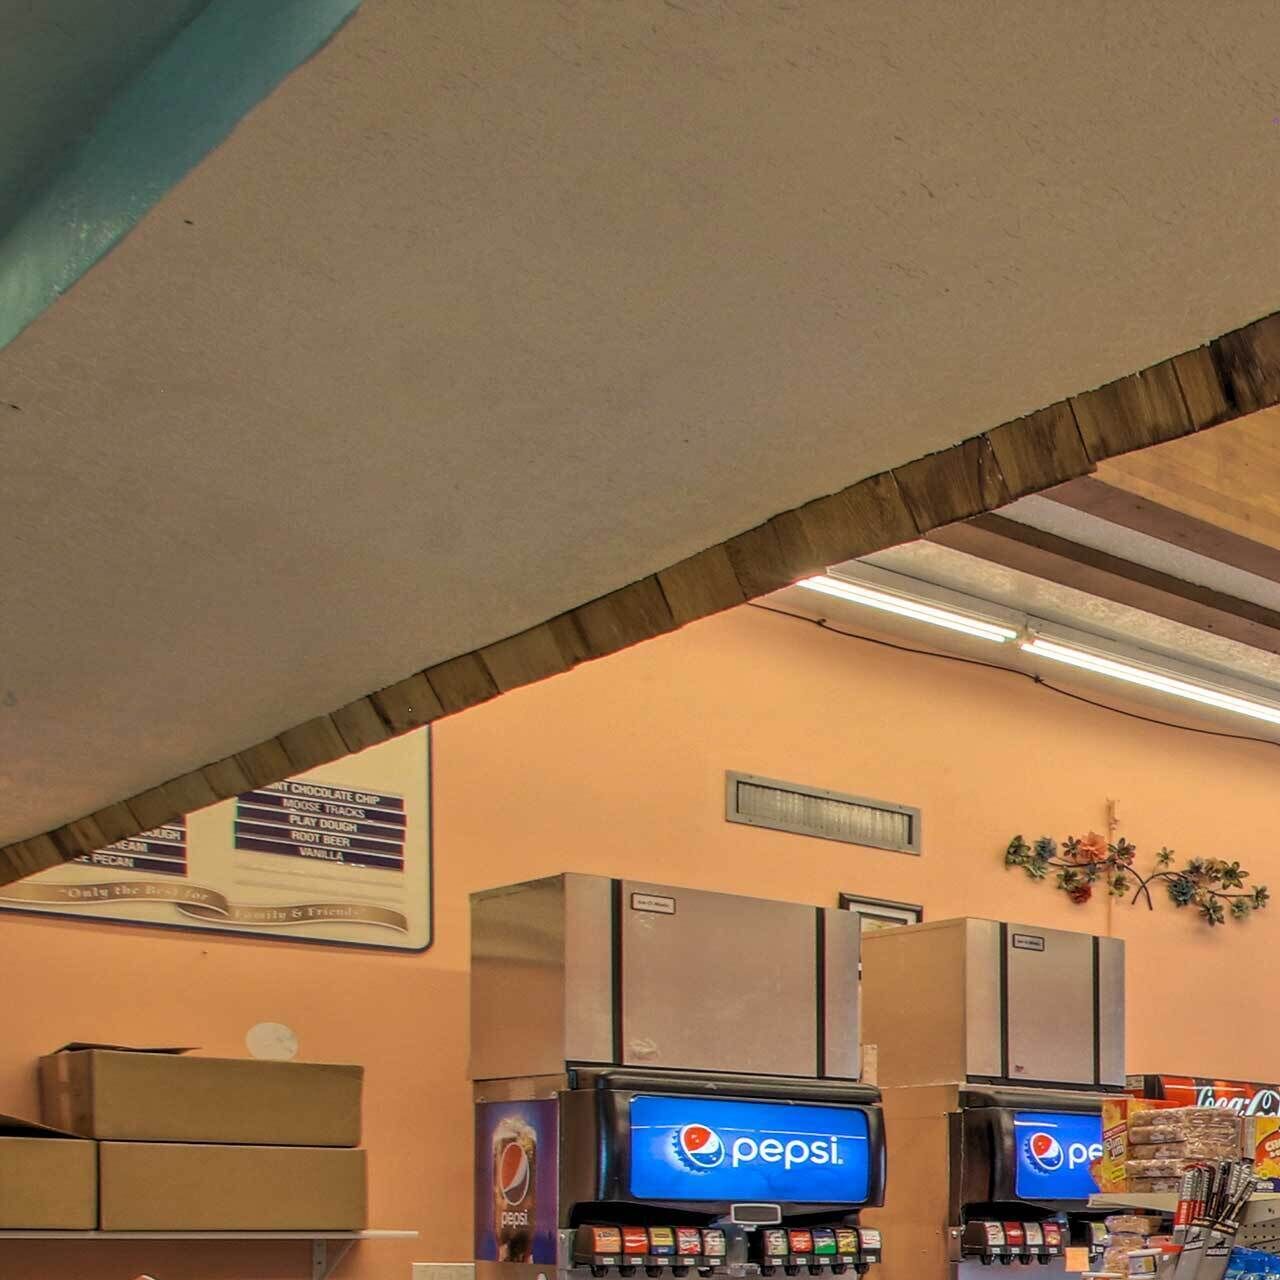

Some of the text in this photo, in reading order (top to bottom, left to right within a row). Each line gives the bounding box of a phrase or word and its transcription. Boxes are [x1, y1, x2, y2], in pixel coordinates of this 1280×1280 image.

[291, 784, 353, 802] CHOCOLATE
[355, 793, 380, 805] CHIP
[282, 798, 366, 819] MOOSE TRACKS
[289, 814, 358, 833] PLAY DOUGH
[290, 830, 350, 847] ROOT BEER
[92, 853, 135, 868] PECAN
[298, 847, 345, 861] VANILLA
[732, 1135, 839, 1169] pepsi
[501, 1208, 529, 1229] pepsi
